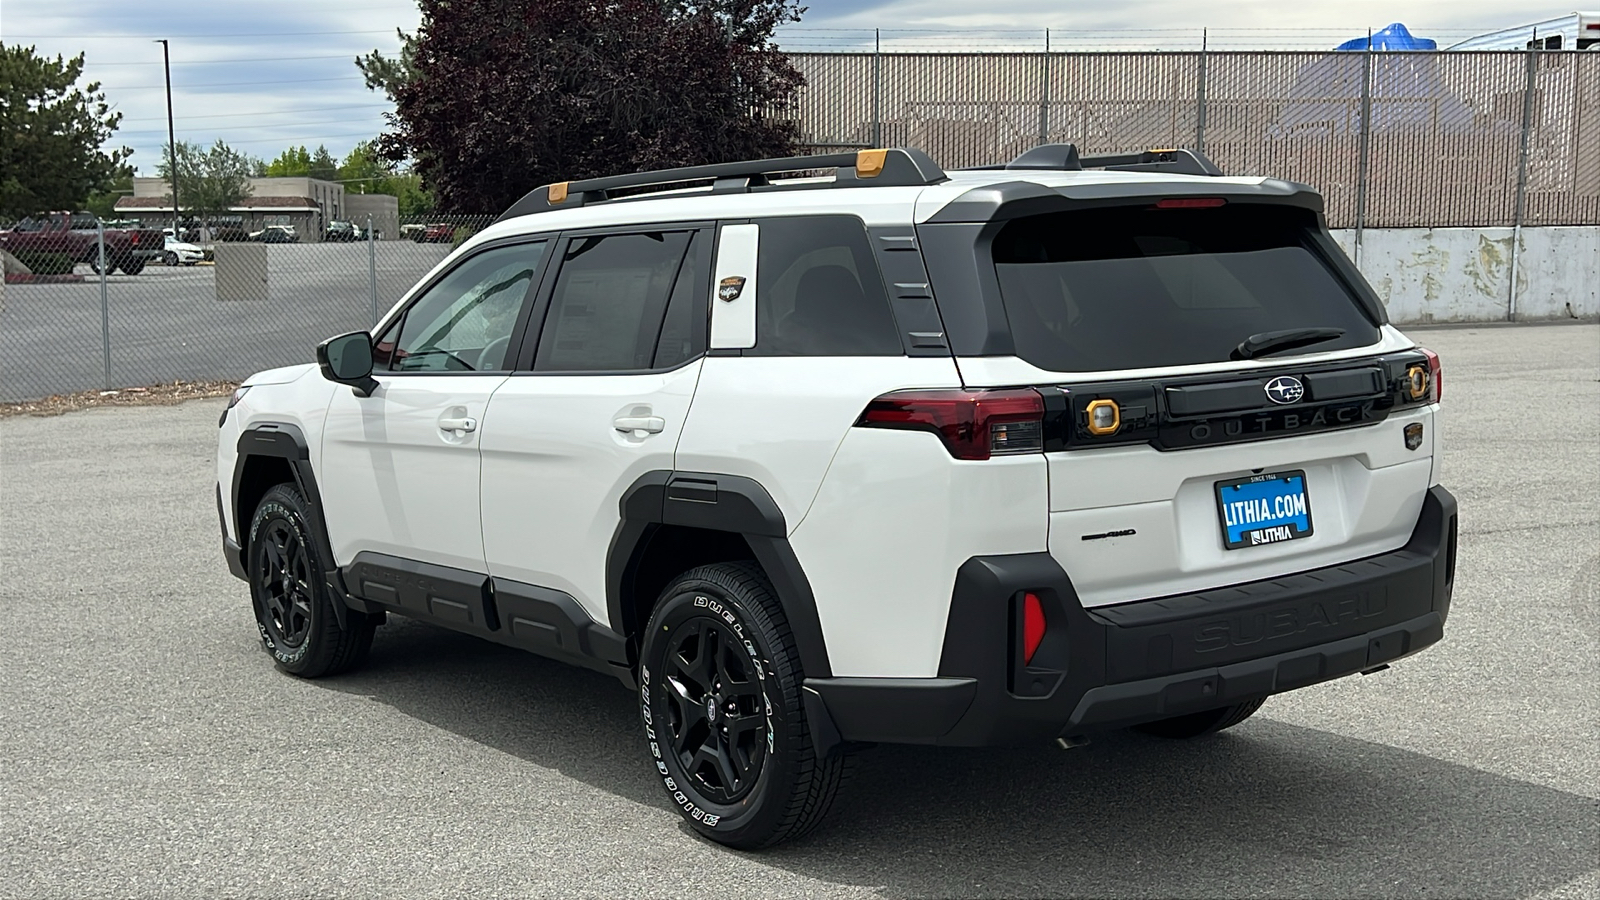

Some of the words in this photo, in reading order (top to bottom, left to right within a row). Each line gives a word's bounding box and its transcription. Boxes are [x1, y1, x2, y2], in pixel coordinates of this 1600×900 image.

[1190, 400, 1374, 441] OUTBACK
[1250, 475, 1265, 483] SINCE
[1223, 492, 1307, 527] LITHIA.COM
[1260, 526, 1293, 544] LITHIA
[693, 596, 765, 681] DUELER
[1194, 584, 1388, 653] SUBARU
[642, 664, 721, 827] BRIDGESTONE
